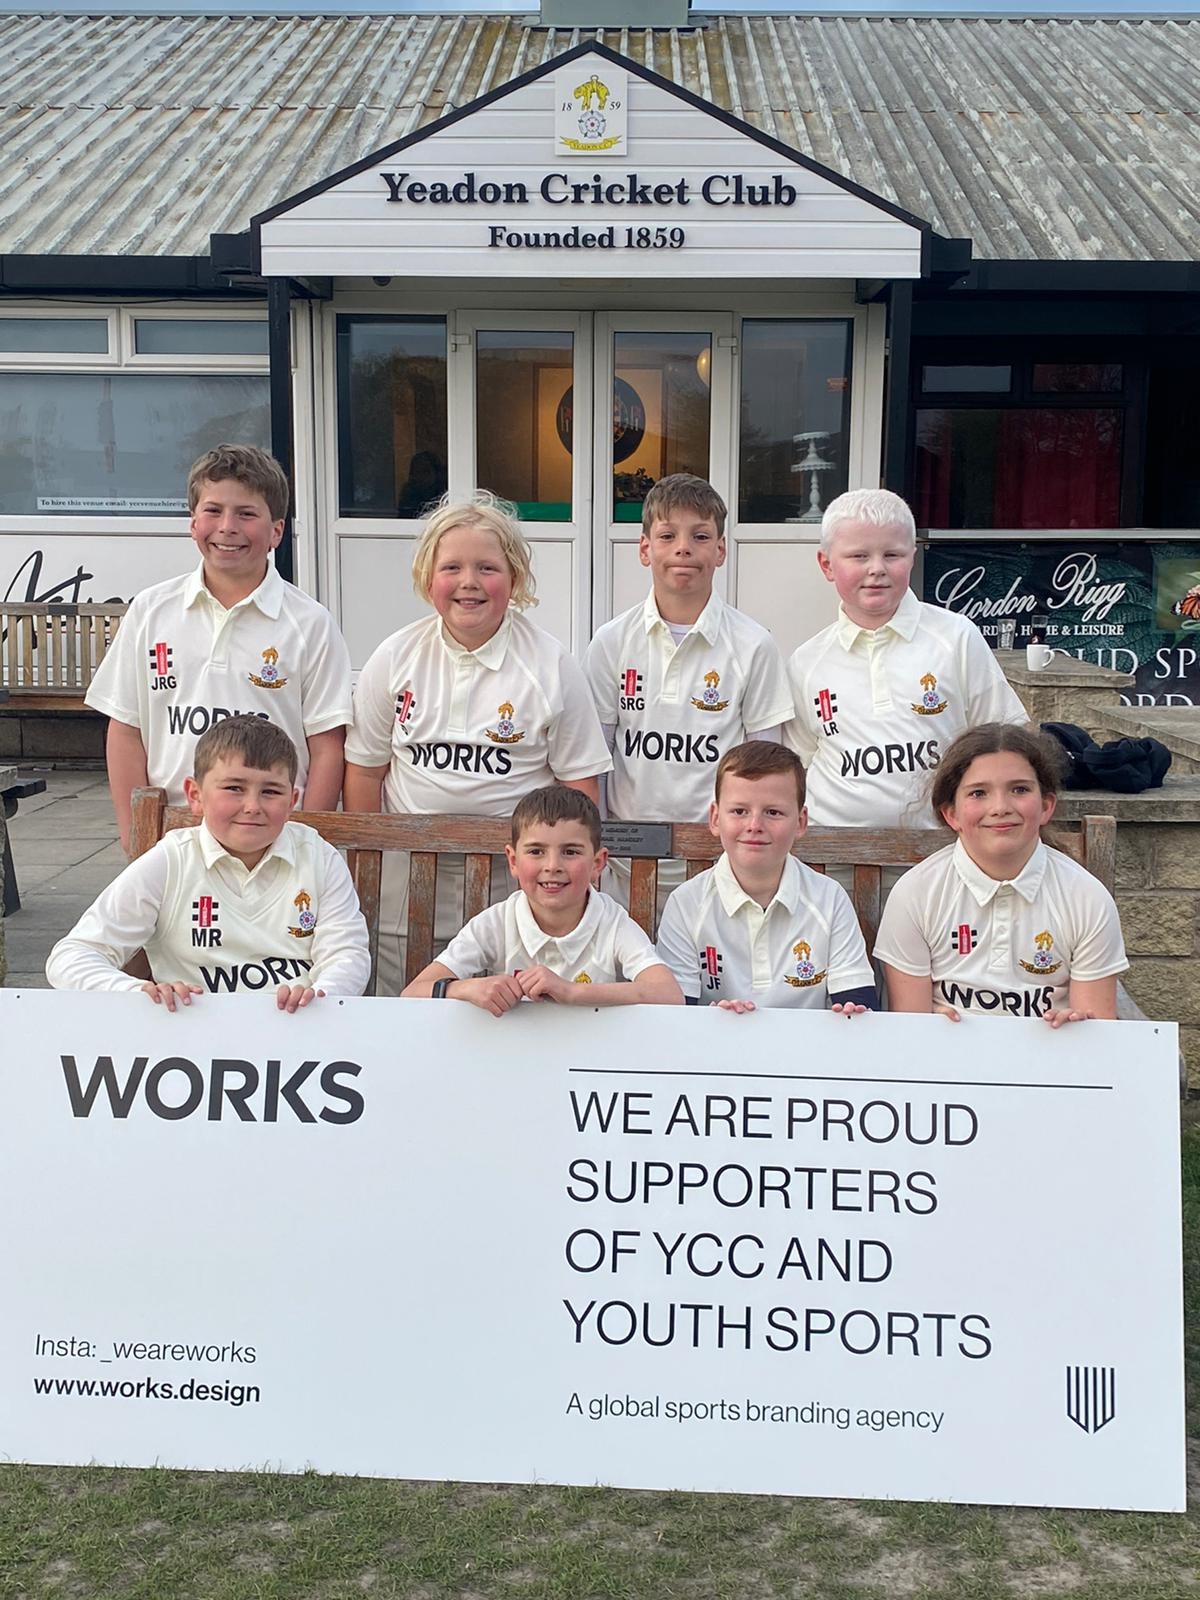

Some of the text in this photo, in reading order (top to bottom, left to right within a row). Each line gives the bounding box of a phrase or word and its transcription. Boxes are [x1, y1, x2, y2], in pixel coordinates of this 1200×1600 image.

[561, 102, 621, 111] 18 59
[380, 173, 797, 206] Yeadon Cricket Club
[488, 226, 685, 249] Founded 1859
[51, 499, 66, 507] hire
[67, 499, 81, 507] this
[935, 552, 1126, 621] Gordon Rigg
[1062, 625, 1071, 636] &
[1073, 624, 1125, 637] LEISURE
[151, 676, 177, 690] JRG
[620, 697, 645, 710] SRG
[823, 721, 839, 736] LR
[406, 742, 512, 775] WORKS
[841, 740, 941, 777] WORKS
[191, 928, 222, 947] MR
[60, 1055, 365, 1125] WORKS
[569, 1090, 979, 1146] WE ARE PROUD
[566, 1159, 938, 1215] SUPPORTERS
[565, 1228, 893, 1283] OF YCC AND
[563, 1299, 992, 1360] YOUTH SPORTS
[35, 1334, 256, 1364] Insta: _weareworks
[34, 1377, 261, 1407] www.works.design
[565, 1392, 945, 1433] A global sports branding agency
